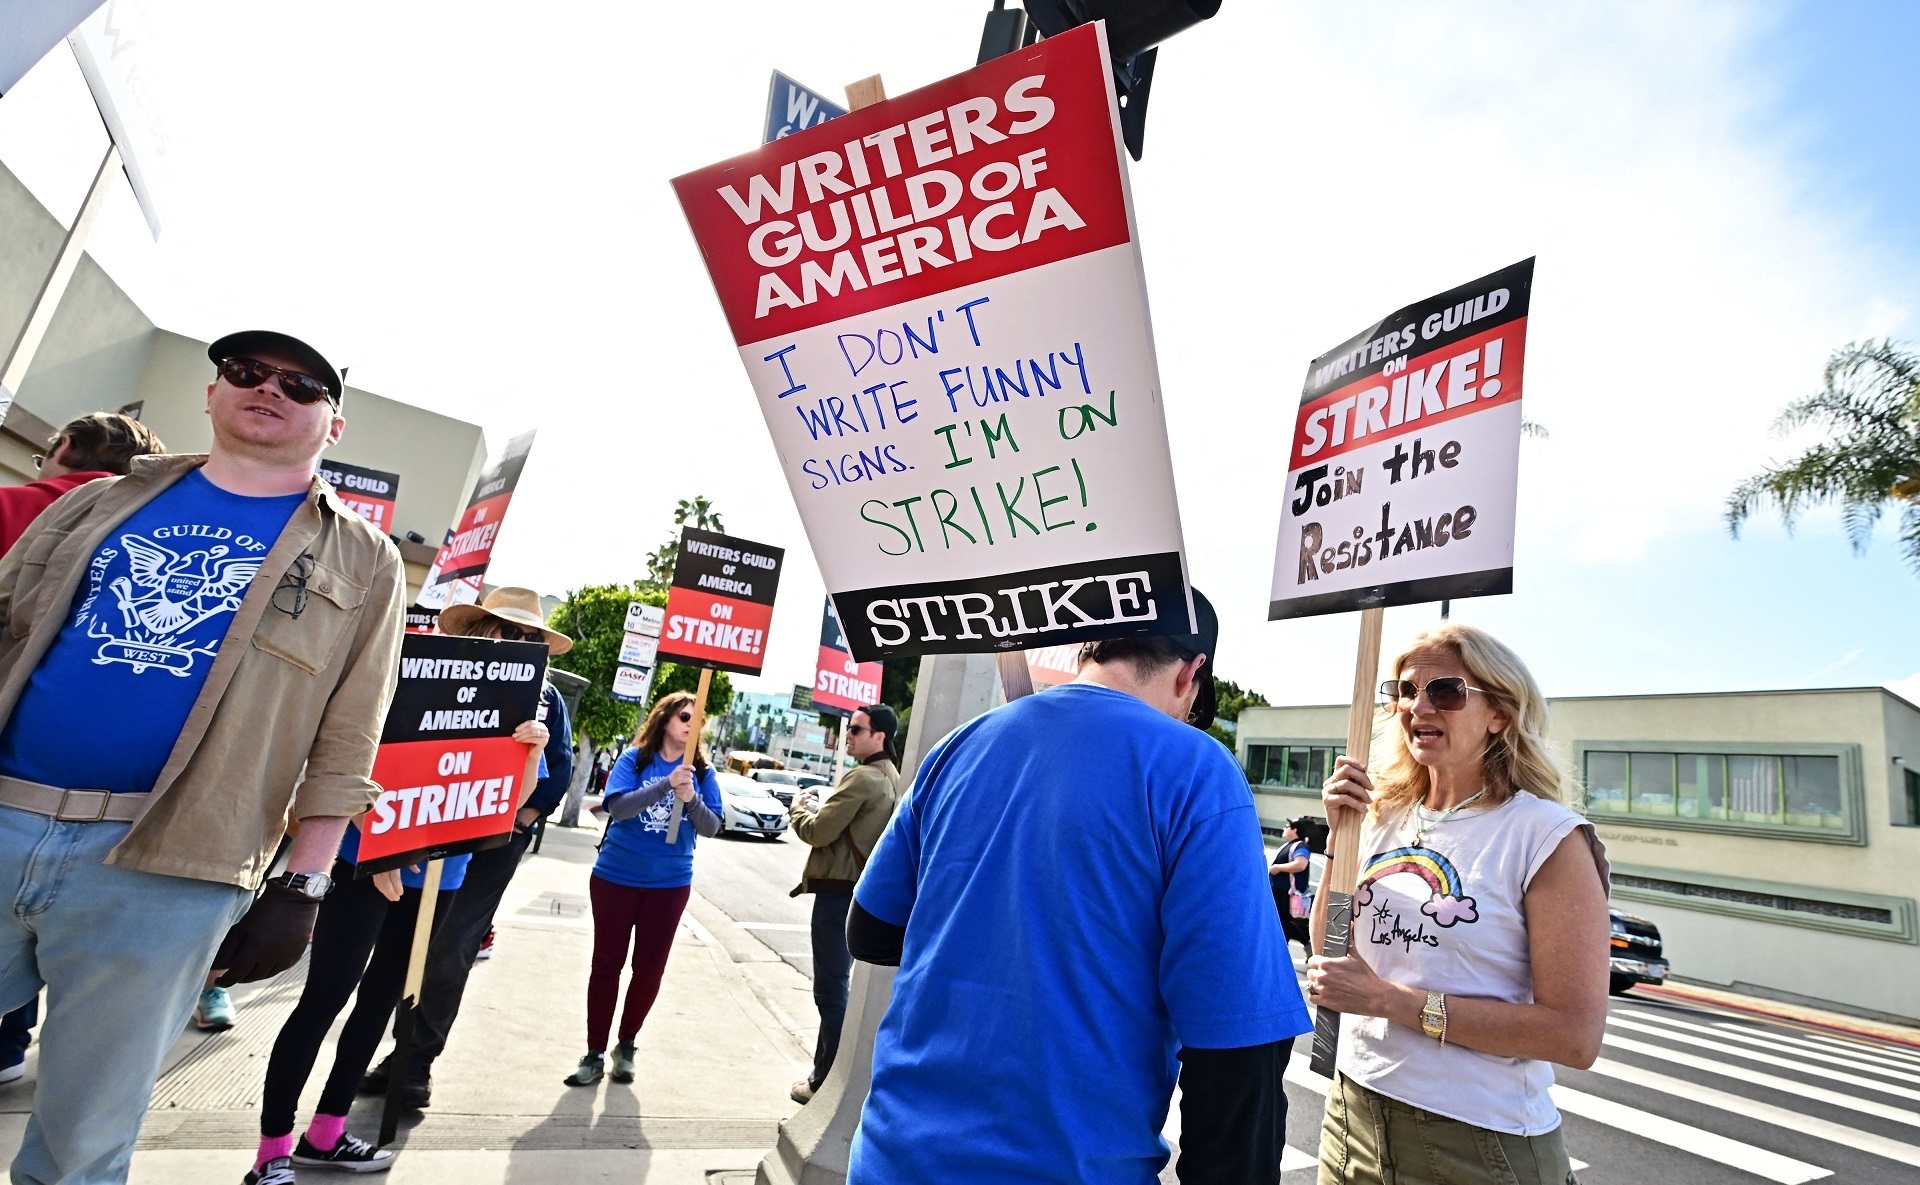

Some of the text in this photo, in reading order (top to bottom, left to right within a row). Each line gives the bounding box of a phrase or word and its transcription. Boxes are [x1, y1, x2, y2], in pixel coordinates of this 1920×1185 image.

[717, 74, 1056, 226] WRITERS
[747, 147, 1047, 268] GUILD OF
[755, 187, 1087, 320] AMERICA
[764, 296, 990, 399] I DON'T
[1314, 288, 1511, 389] WRITERS GUILD
[1382, 354, 1408, 378] ON
[795, 342, 1092, 441] WRITE FUNNY
[1301, 337, 1504, 458] STRIKE!
[802, 389, 1118, 490] SIGNS. I'M ON
[1383, 437, 1462, 485] the
[344, 474, 390, 494] GUILD
[473, 507, 489, 525] ON
[860, 457, 1098, 556] STRIKE!
[447, 521, 499, 560] STRIKE!
[686, 539, 777, 571] WRITERS GUILD
[74, 524, 267, 628] WRITERS GUILD OF
[170, 577, 201, 587] united
[698, 573, 753, 597] AMERICA
[722, 564, 737, 576] OF
[166, 587, 193, 597] stand
[866, 570, 1158, 648] STRIKE
[626, 621, 635, 630] 10
[710, 602, 734, 620] ON
[666, 614, 763, 655] STRIKE!
[123, 647, 171, 664] WEST
[401, 657, 536, 682] WRITERS GUILD
[843, 660, 860, 676] ON
[619, 670, 646, 682] DASH
[817, 669, 878, 705] STRIKE!
[456, 687, 478, 704] OF
[418, 709, 500, 732] AMERICA
[437, 750, 473, 777] ON
[370, 775, 515, 836] STRIKE!
[1370, 914, 1439, 953] Los Angeles
